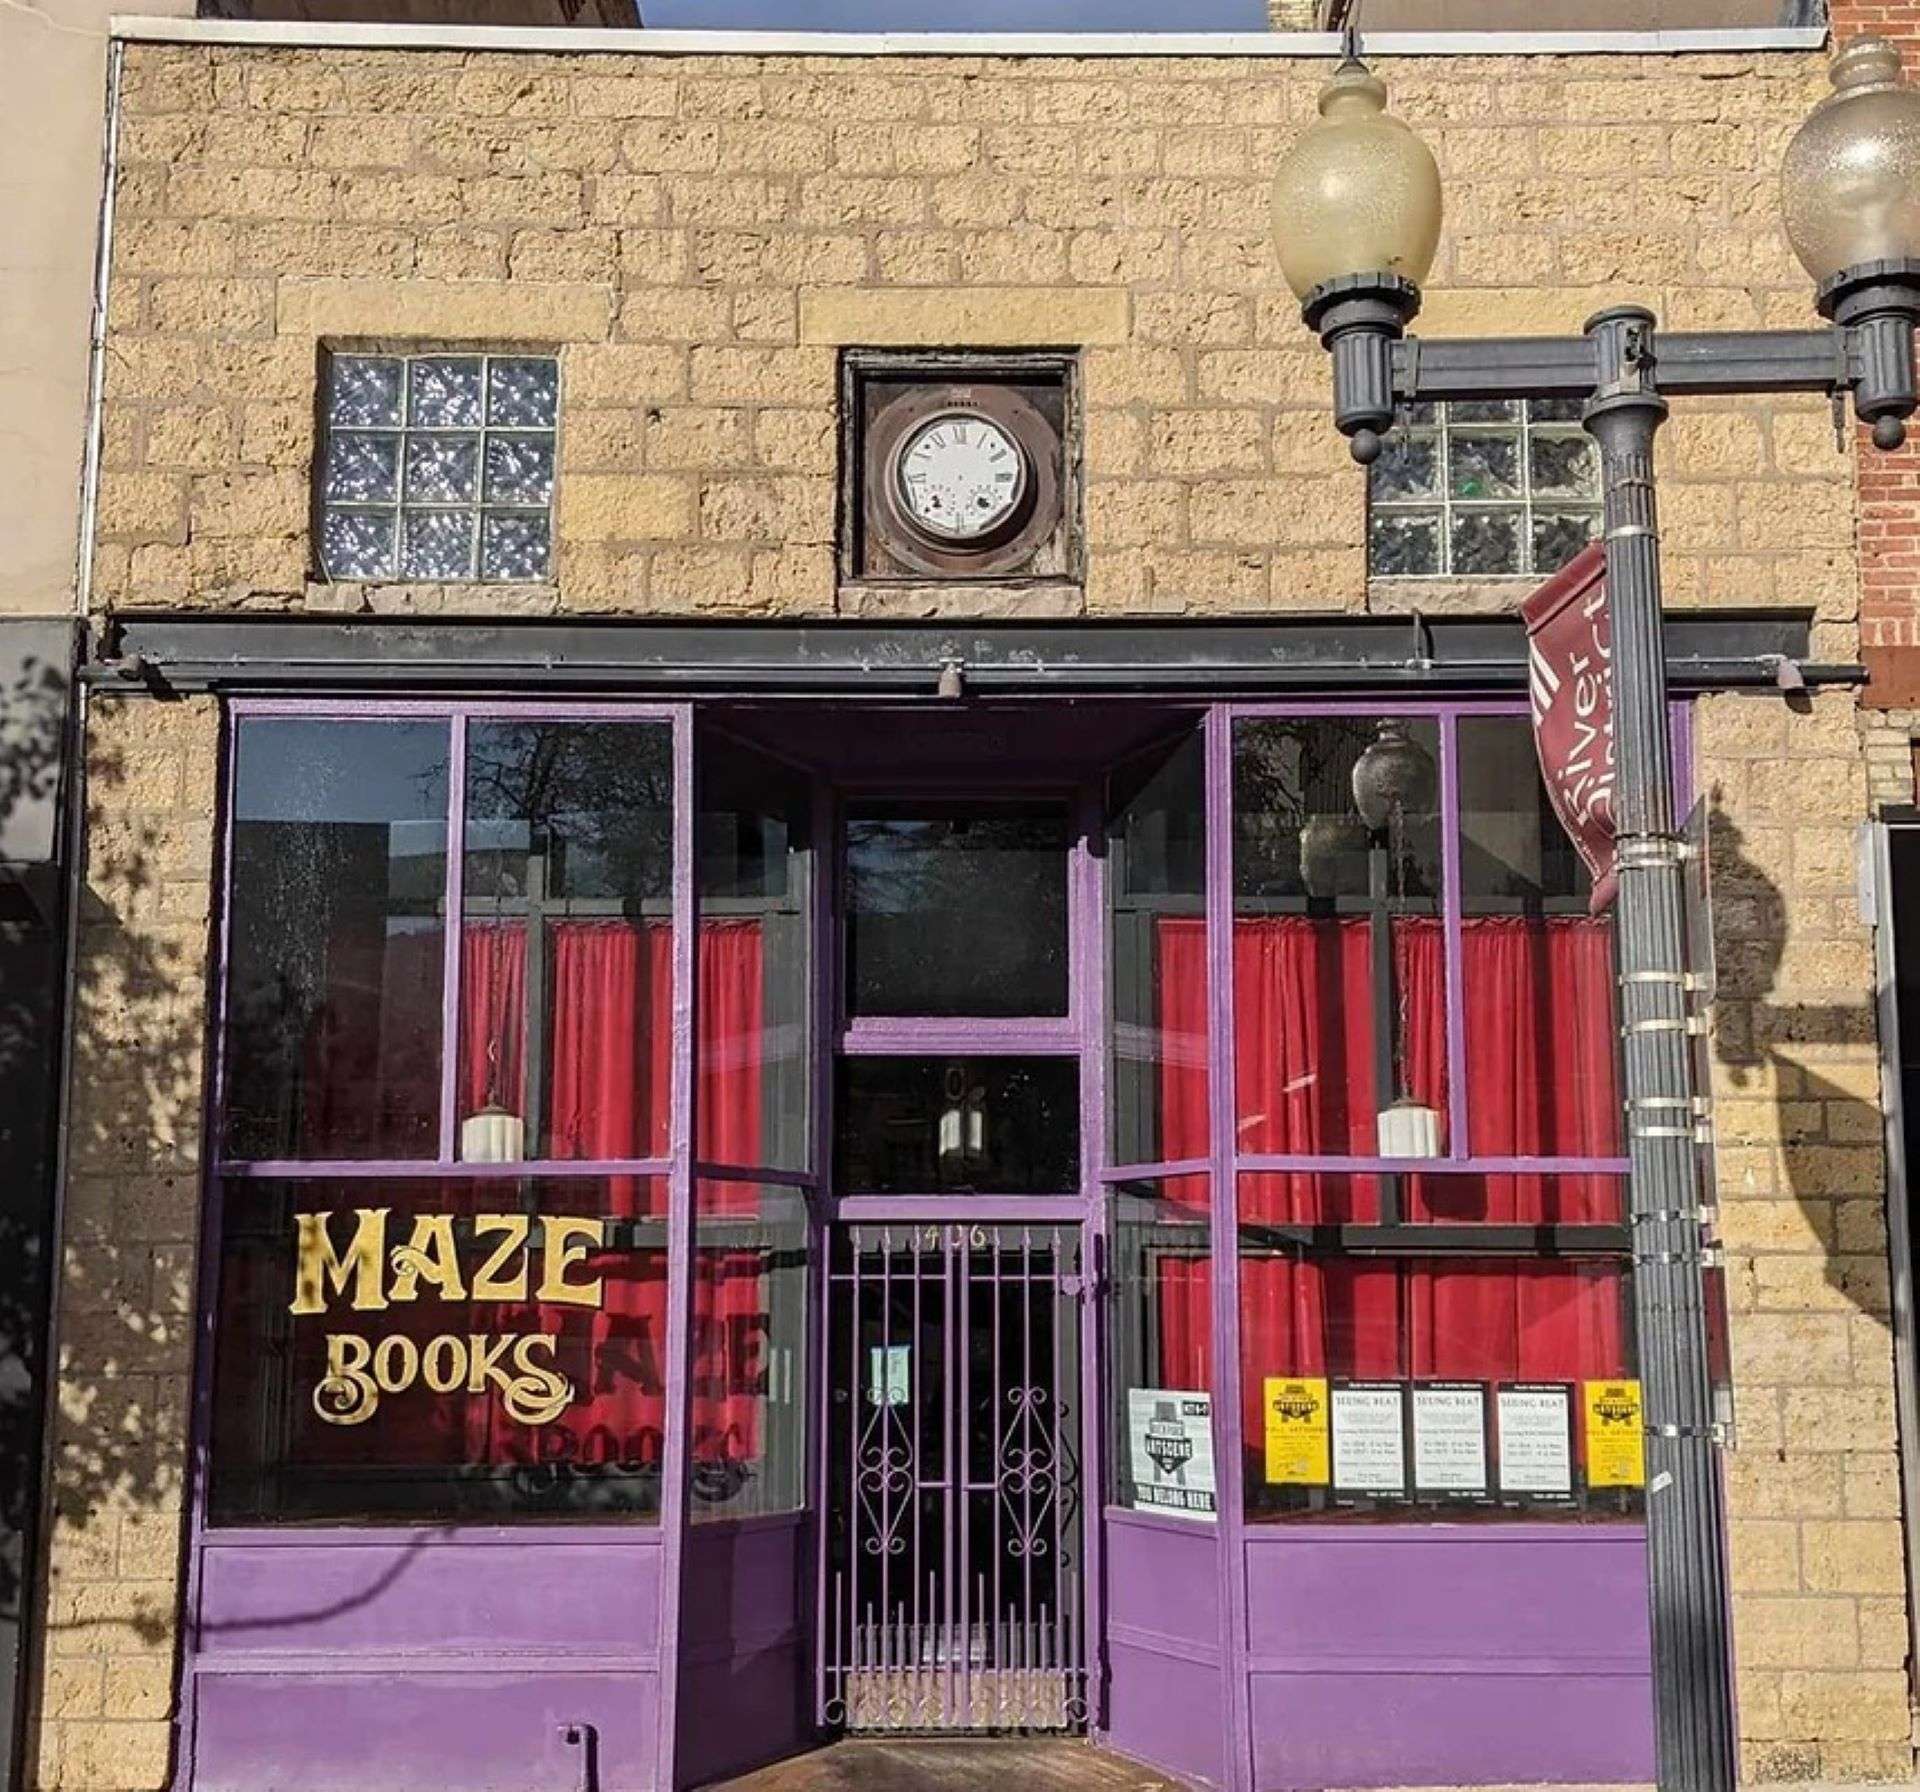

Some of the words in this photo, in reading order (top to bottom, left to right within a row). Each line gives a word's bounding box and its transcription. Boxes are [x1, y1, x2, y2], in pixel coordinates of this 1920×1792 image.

[1558, 652, 1597, 827] River
[289, 1207, 604, 1315] MAZE
[312, 1334, 575, 1425] BOOKS
